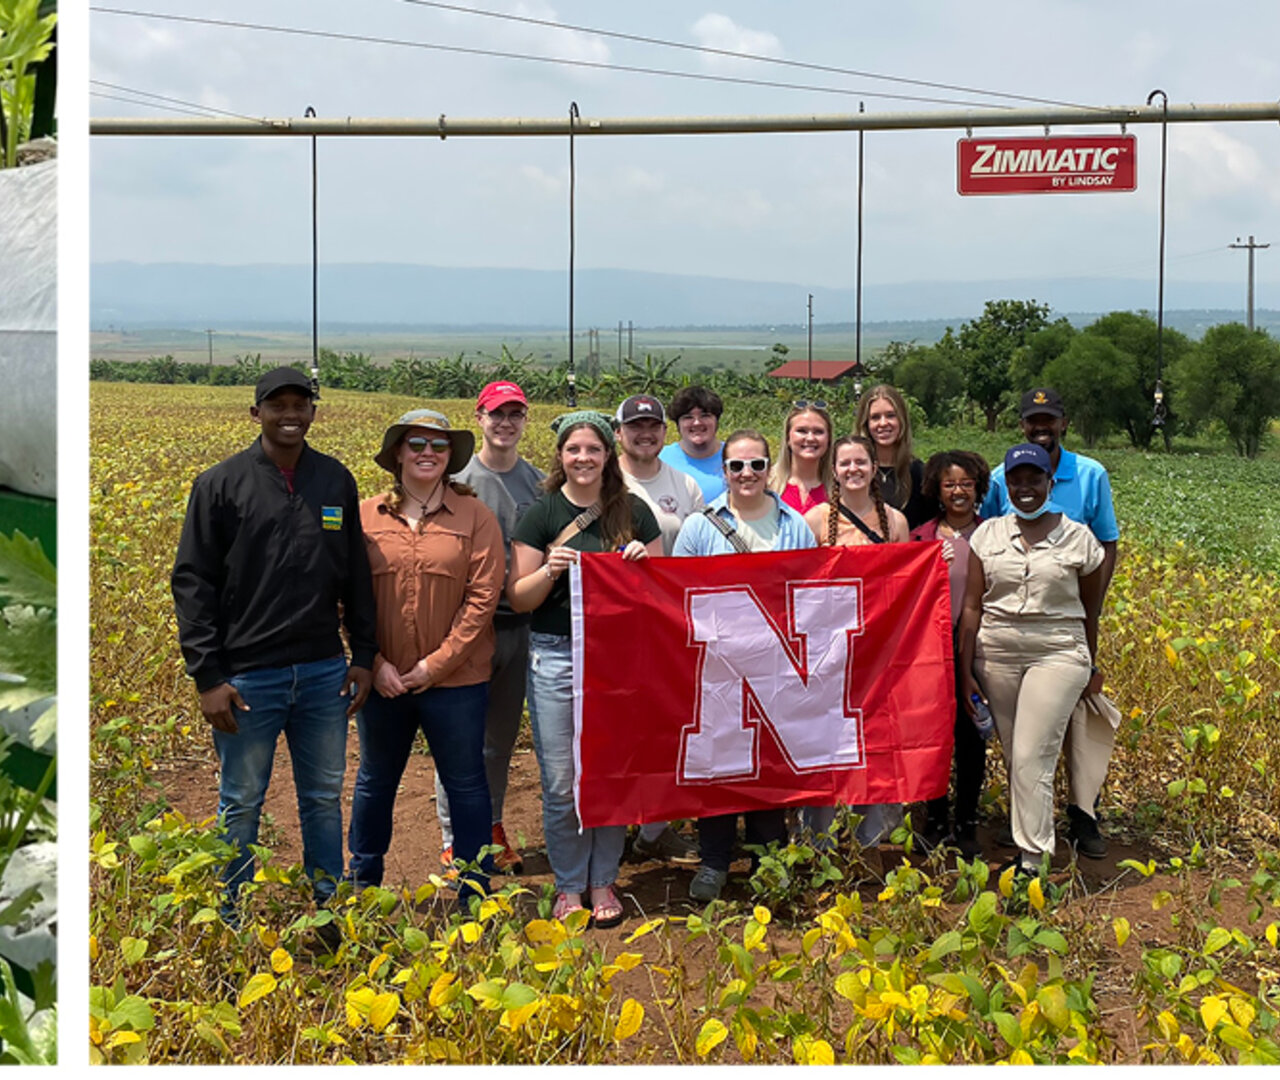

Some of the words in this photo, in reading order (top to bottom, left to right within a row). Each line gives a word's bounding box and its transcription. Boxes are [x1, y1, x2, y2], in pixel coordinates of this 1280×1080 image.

[971, 145, 1120, 173] ZIMMATIC
[1052, 176, 1066, 187] BY
[1068, 176, 1114, 187] LINDSAY
[677, 578, 867, 785] N
